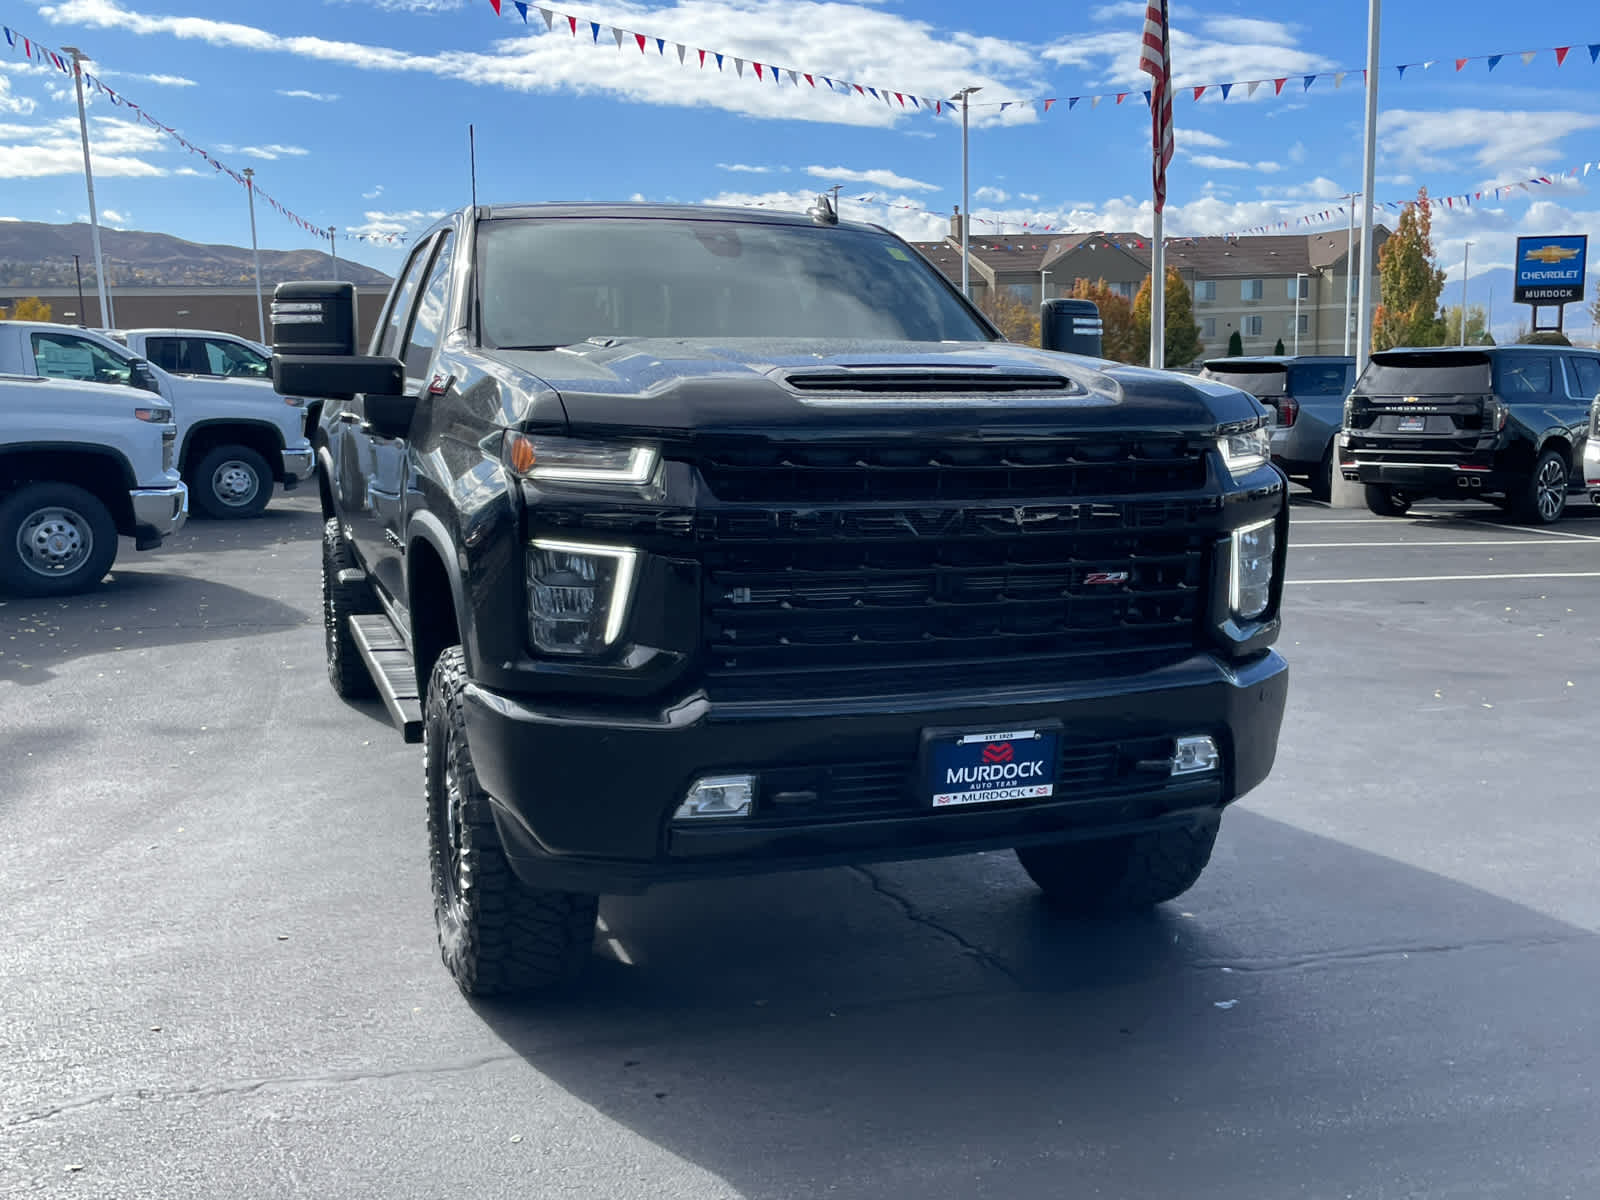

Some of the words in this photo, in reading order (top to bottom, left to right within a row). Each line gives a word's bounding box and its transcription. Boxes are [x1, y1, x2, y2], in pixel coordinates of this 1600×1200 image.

[1521, 270, 1579, 280] CHEVROLET
[1525, 289, 1573, 299] MURDOCK
[946, 760, 1044, 784] MURDOCK
[970, 782, 992, 790] AUTO
[996, 779, 1018, 788] TEAM
[961, 788, 1026, 802] MURDOCK
